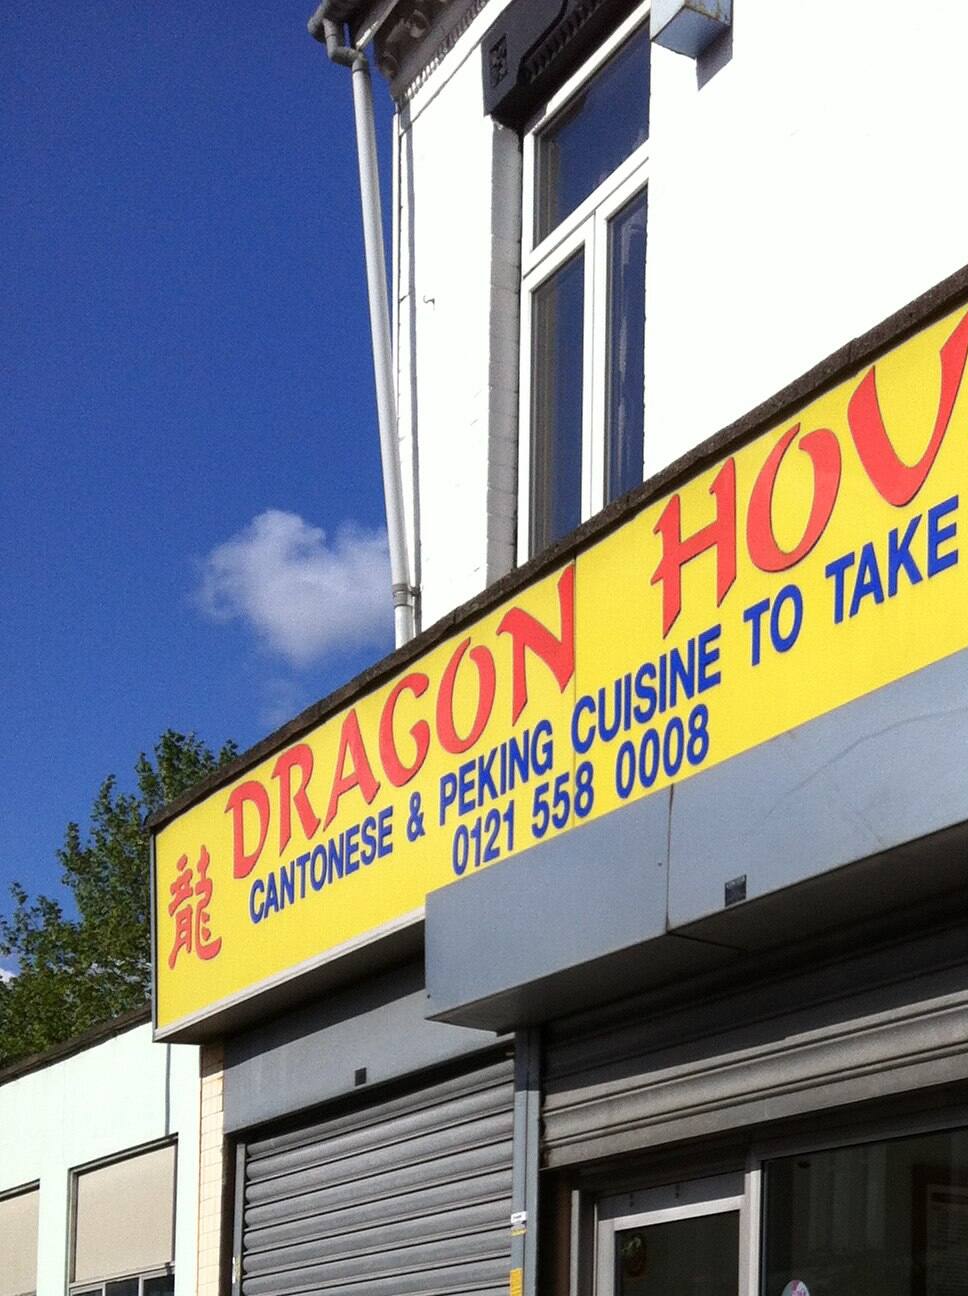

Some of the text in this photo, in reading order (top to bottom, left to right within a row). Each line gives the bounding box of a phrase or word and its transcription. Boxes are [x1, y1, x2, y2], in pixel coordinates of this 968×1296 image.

[224, 563, 577, 880] DRAGON
[248, 804, 394, 924] CANTONESE
[406, 790, 426, 841] &
[439, 719, 554, 826] PEKING
[571, 623, 722, 754] CUISINE
[742, 584, 803, 667] TO
[824, 495, 960, 625] TAKE
[451, 704, 710, 876] 0121 558 0008
[166, 843, 222, 970] 龍
